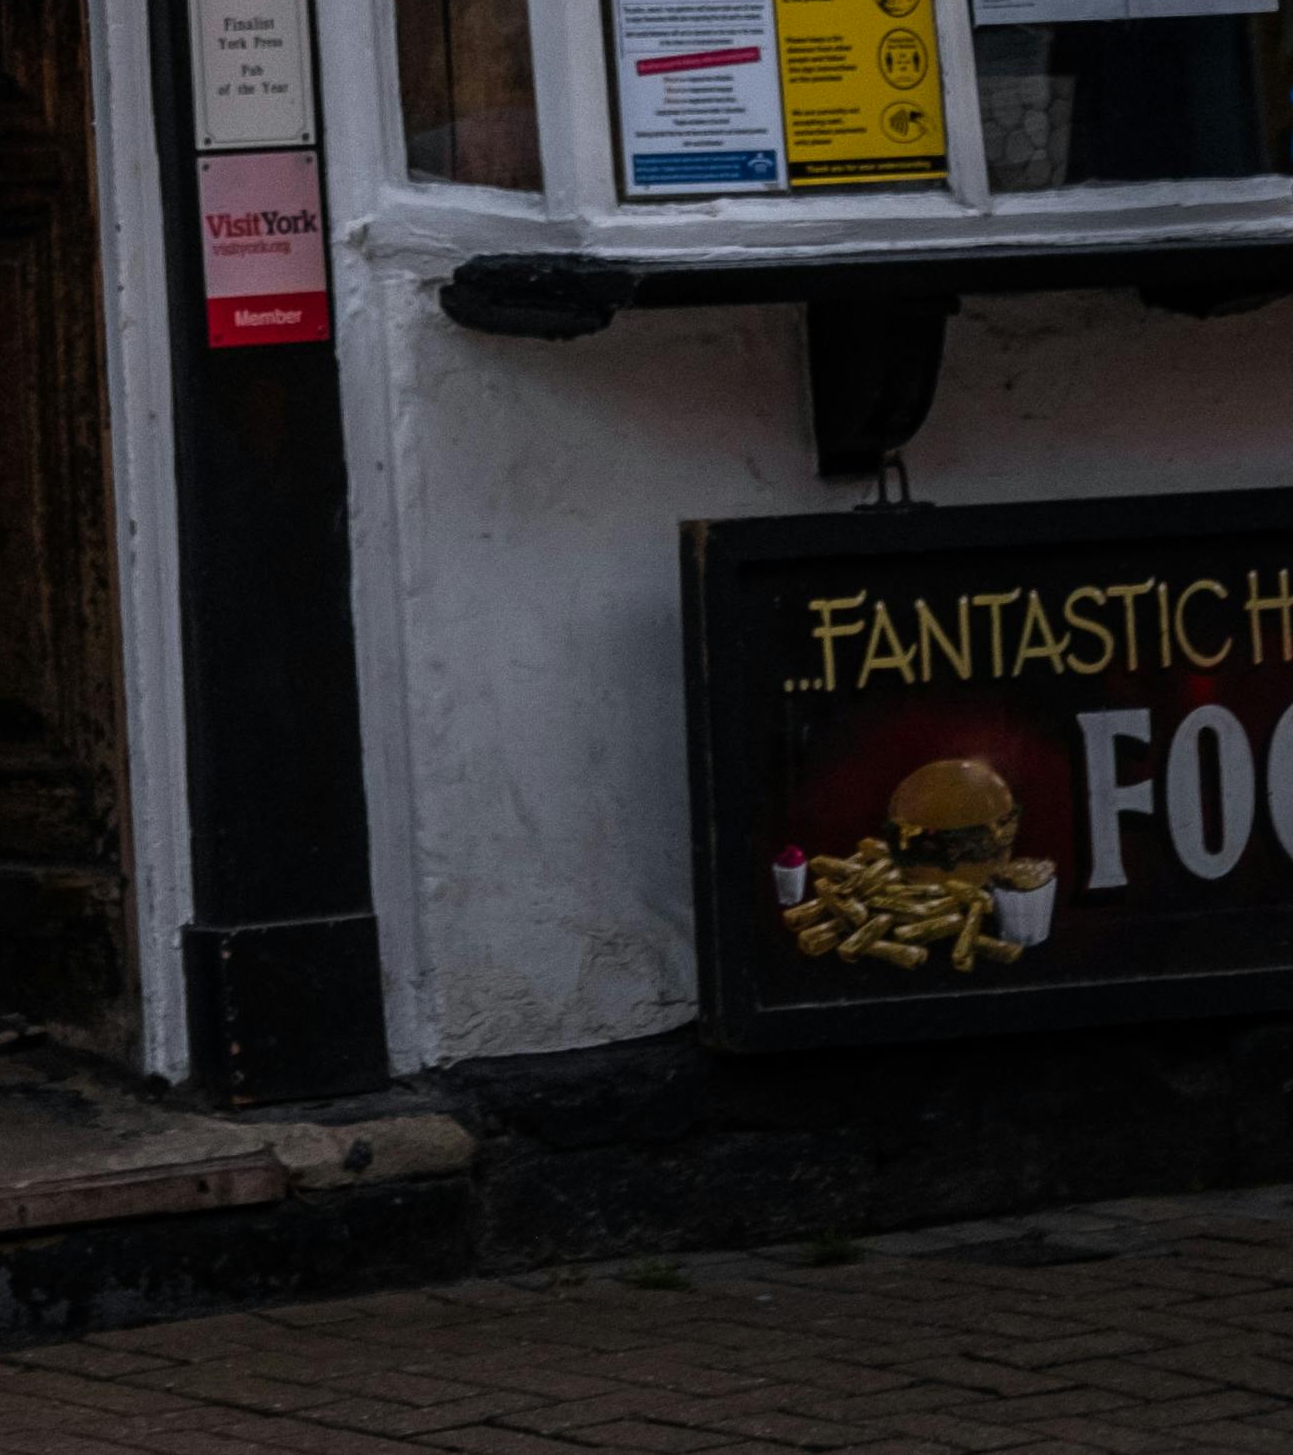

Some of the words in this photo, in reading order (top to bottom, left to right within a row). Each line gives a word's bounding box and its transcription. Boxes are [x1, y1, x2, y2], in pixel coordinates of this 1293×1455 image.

[223, 17, 275, 33] Finalist
[218, 37, 247, 51] York
[241, 65, 264, 77] Pub
[218, 84, 231, 97] of
[237, 83, 255, 96] the
[261, 82, 289, 95] Year
[206, 209, 317, 239] VisitYork
[233, 308, 303, 328] Member
